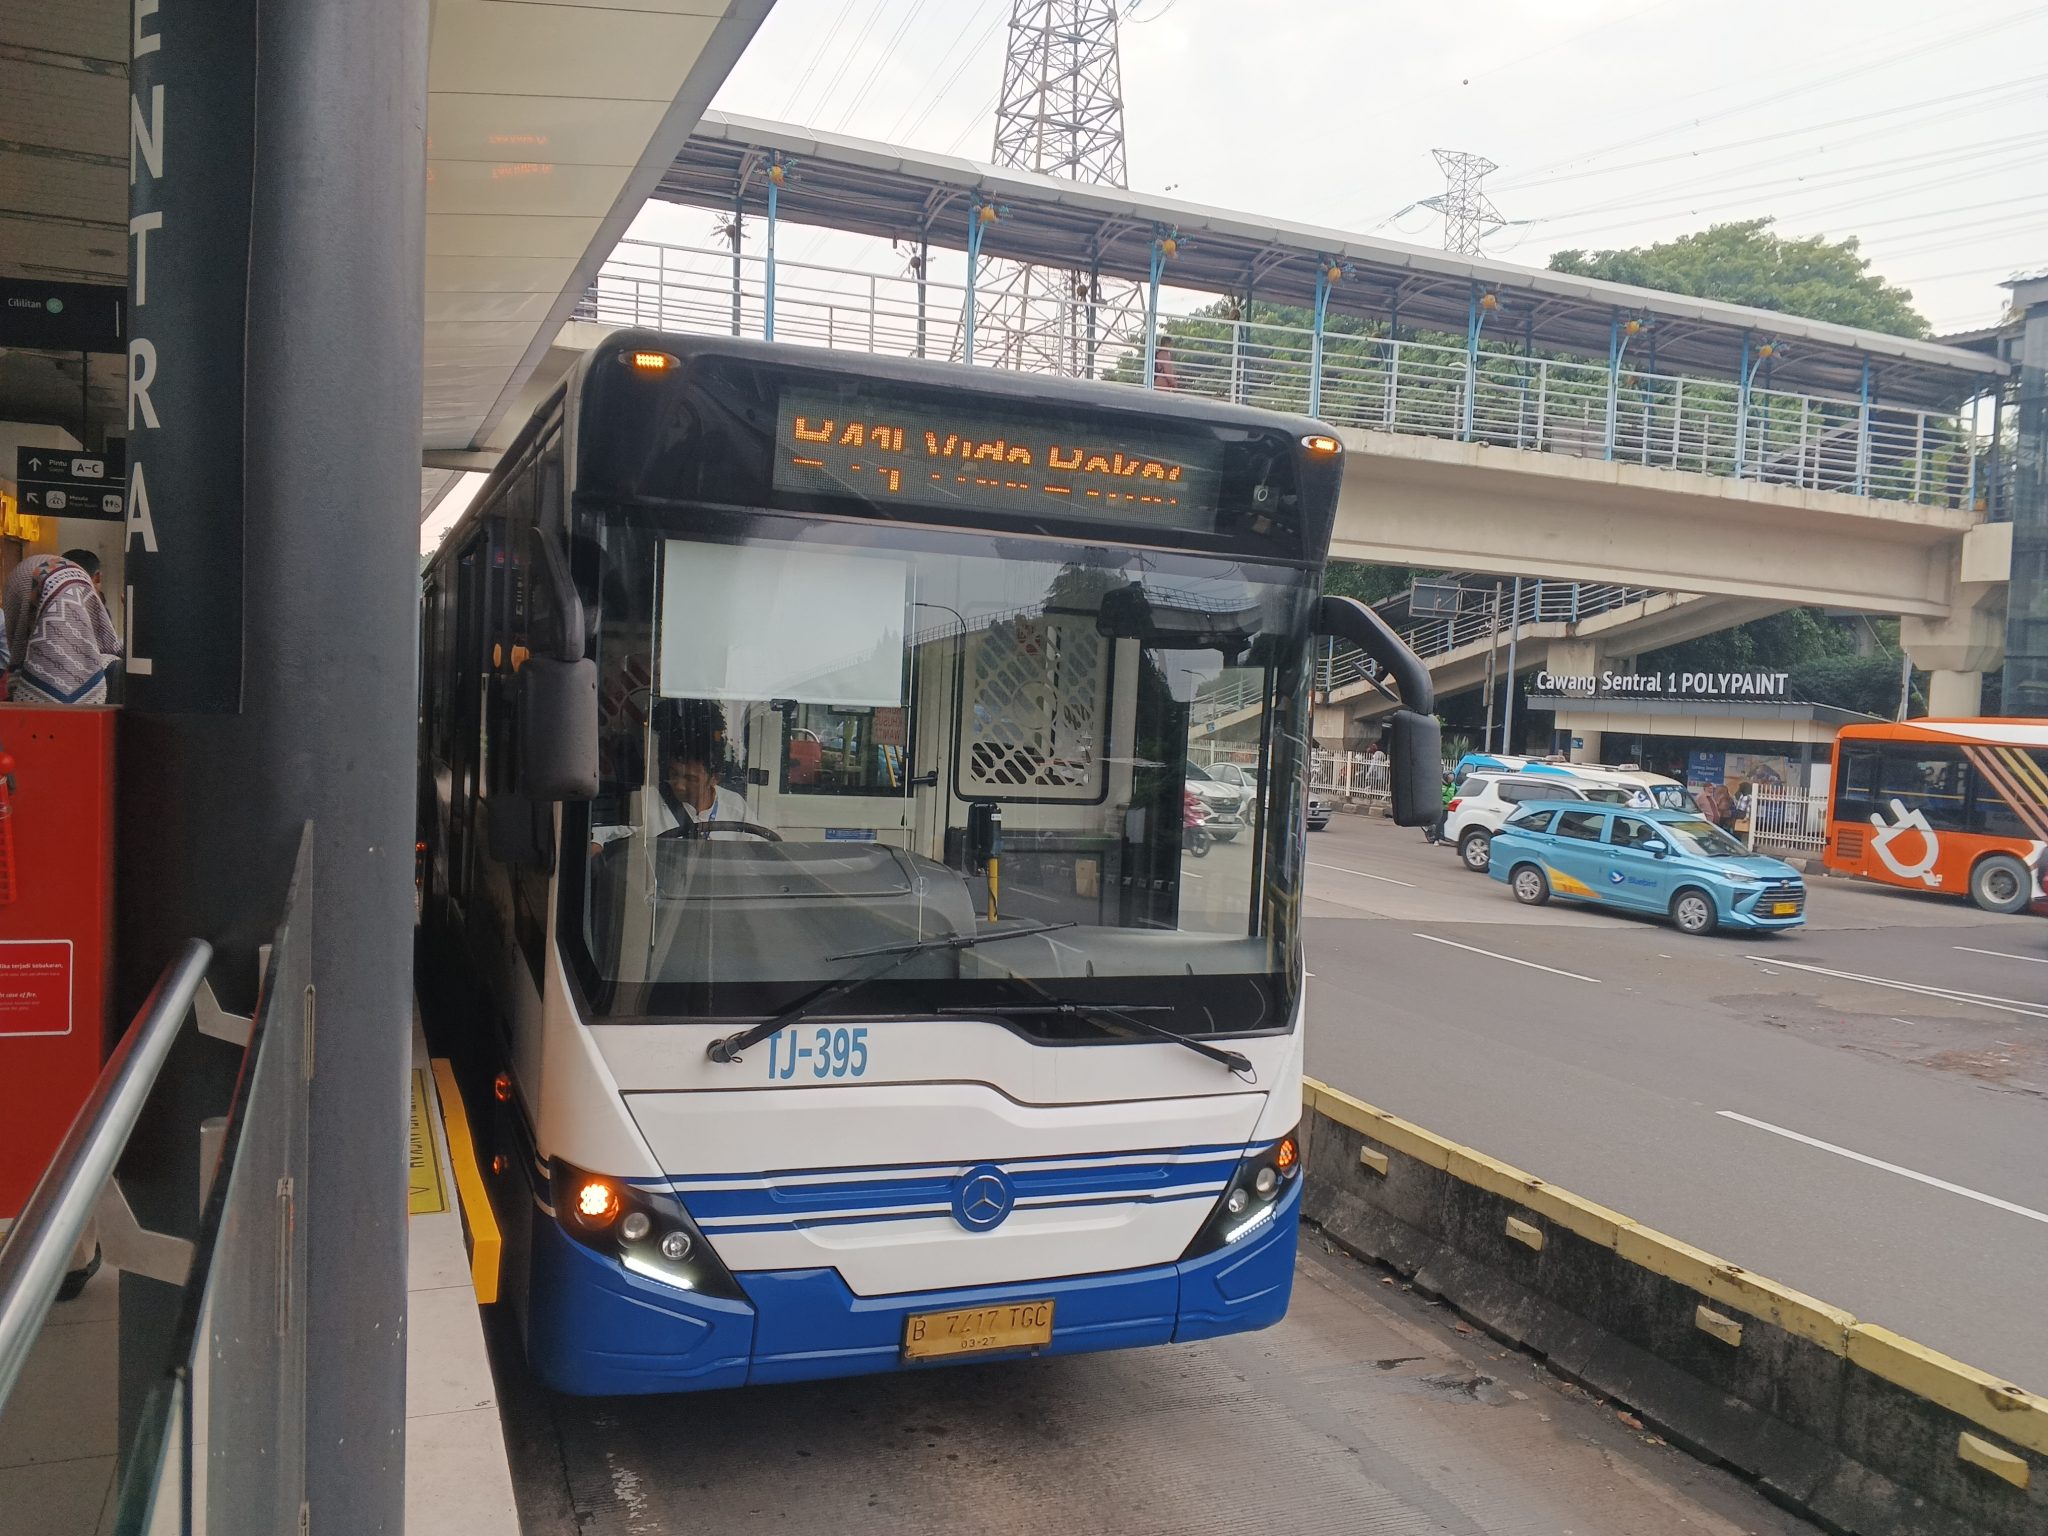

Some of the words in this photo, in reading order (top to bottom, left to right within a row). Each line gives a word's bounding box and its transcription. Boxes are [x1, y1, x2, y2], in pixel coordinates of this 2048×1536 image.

[7, 298, 42, 309] Cililitan
[1536, 671, 1597, 695] Cawang
[1602, 671, 1662, 692] Sentral
[1668, 672, 1677, 693] 1
[1681, 673, 1789, 695] POLYPAINT
[767, 1027, 868, 1080] TJ-395
[912, 1319, 927, 1341] B
[1009, 1305, 1049, 1328] TGC
[960, 1336, 997, 1349] 03-27
